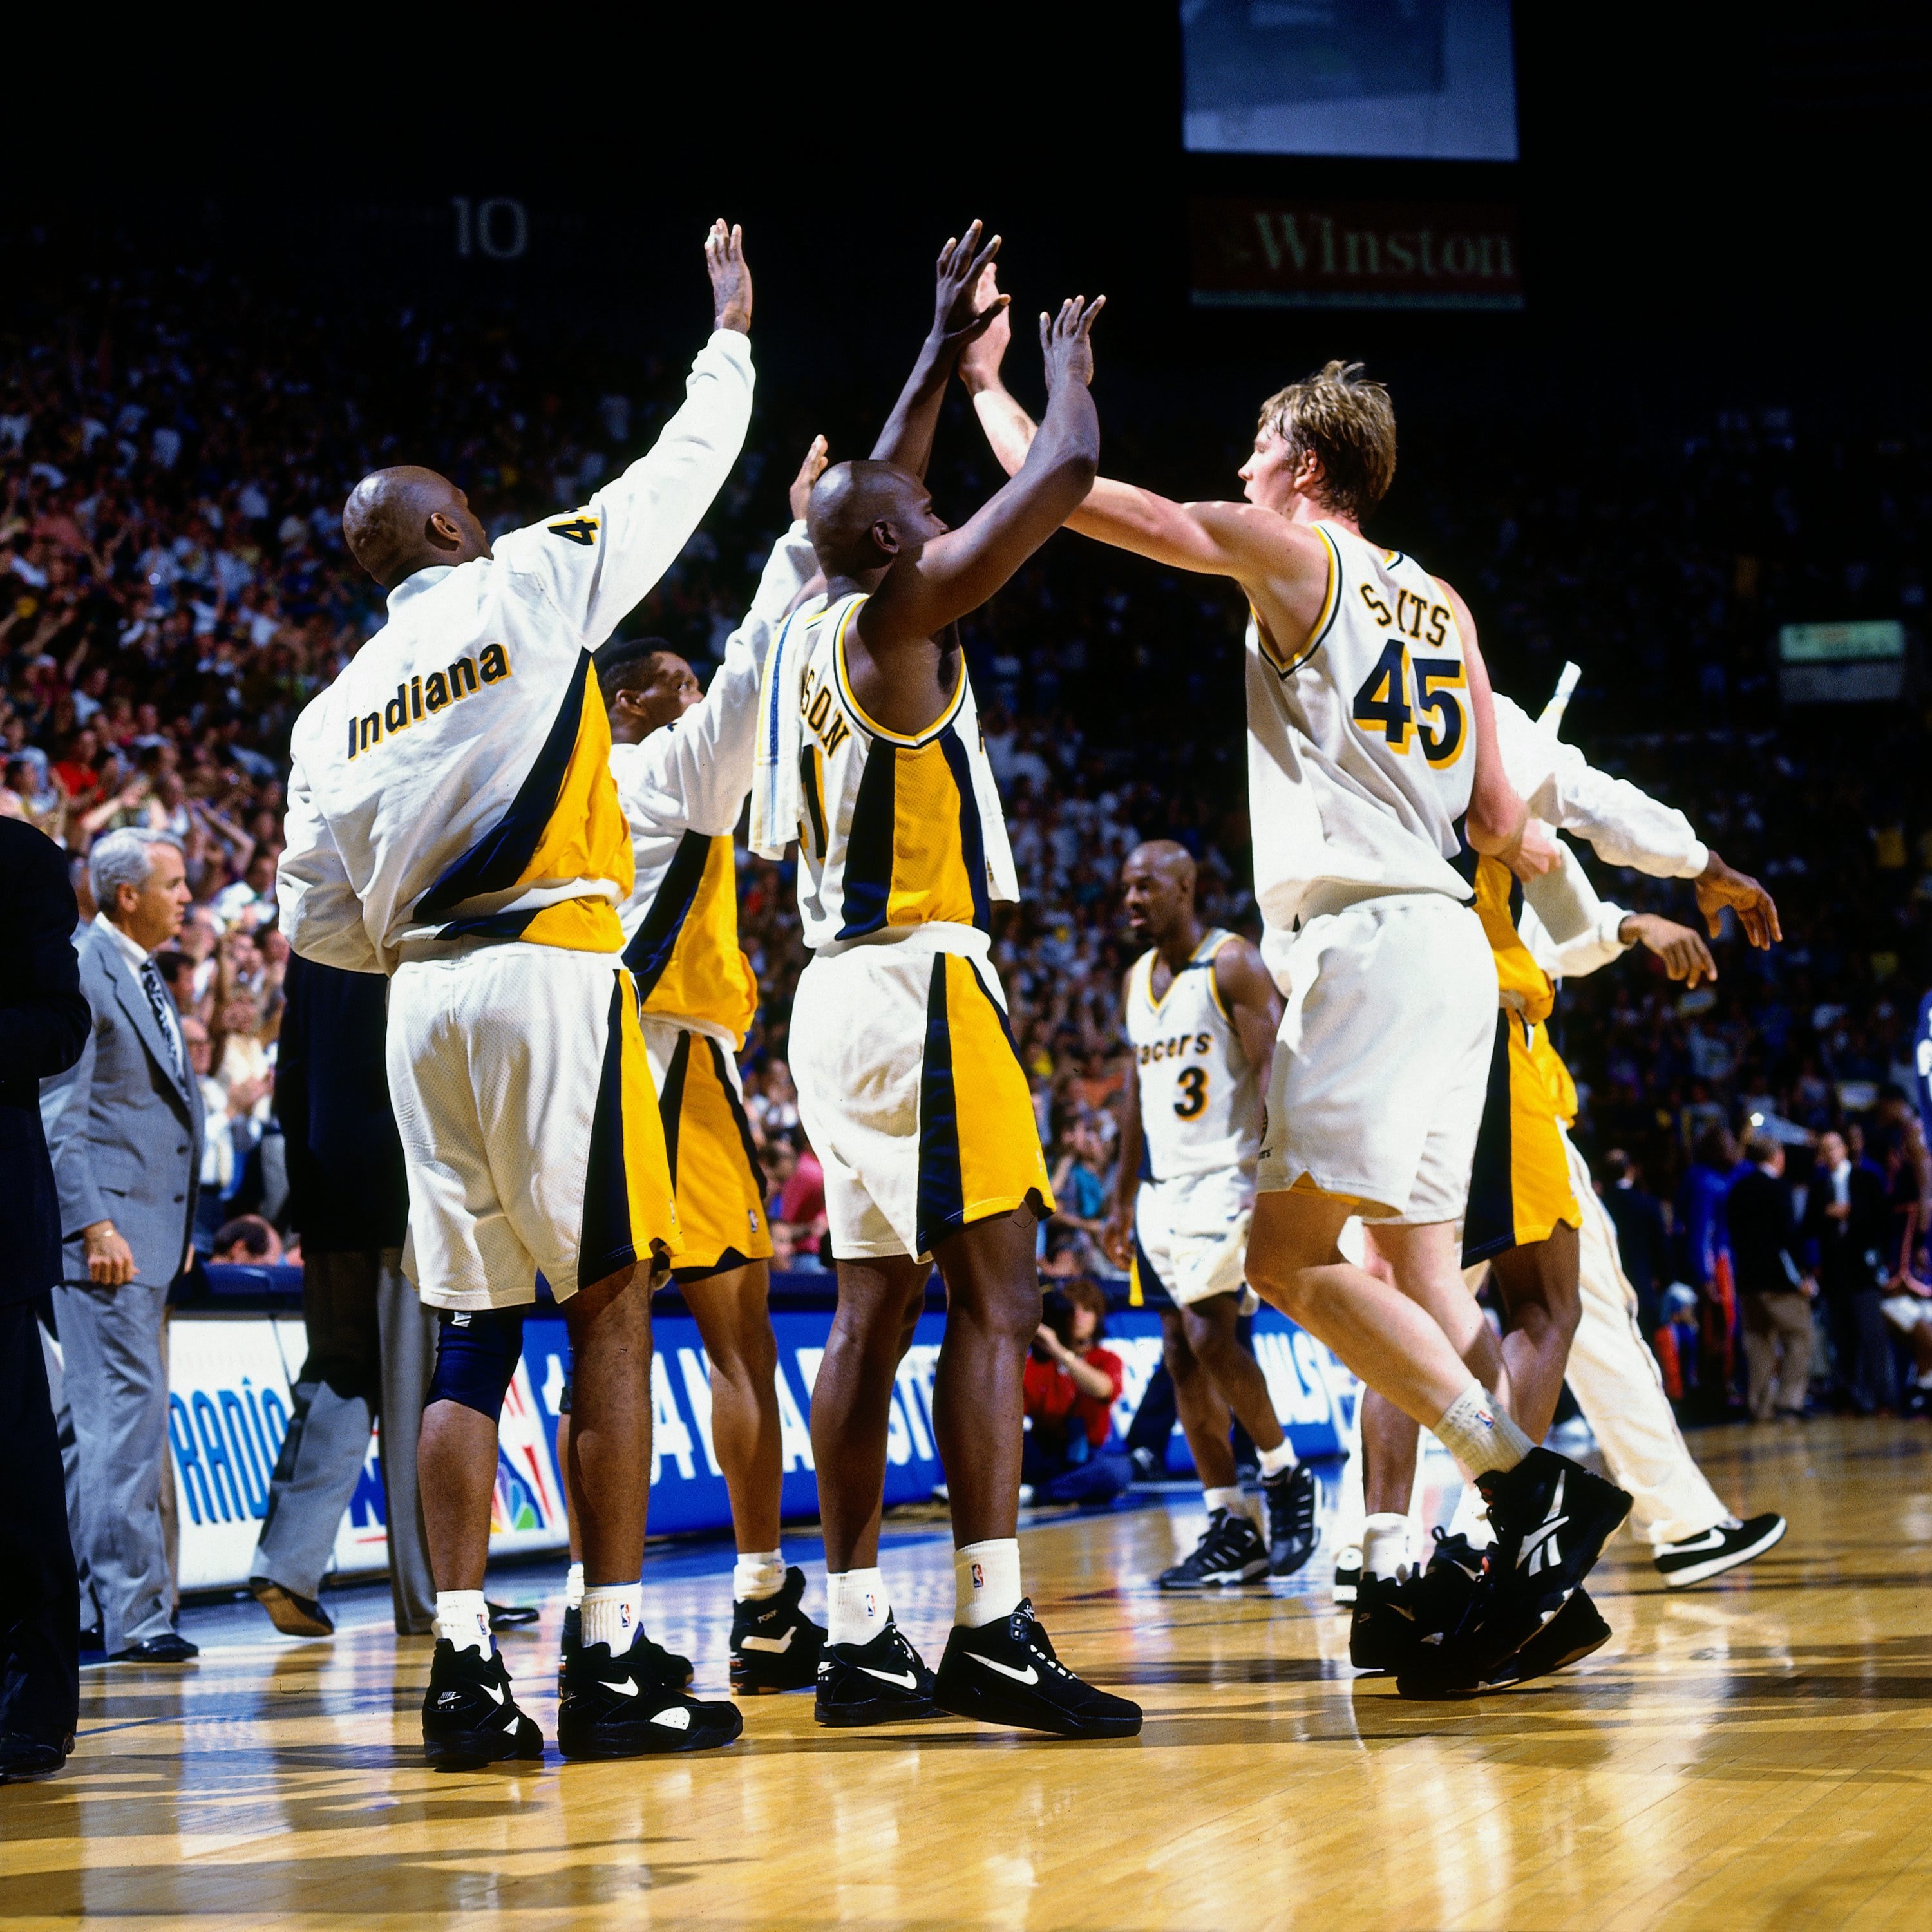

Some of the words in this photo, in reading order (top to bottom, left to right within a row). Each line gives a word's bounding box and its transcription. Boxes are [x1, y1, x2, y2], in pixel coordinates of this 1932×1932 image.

[451, 195, 531, 260] 10
[1251, 210, 1517, 277] Winston
[547, 507, 600, 545] 4
[348, 643, 511, 761] Indiana
[800, 668, 852, 759] SON
[1353, 639, 1468, 770] 45
[1135, 1032, 1213, 1065] acers
[1173, 1066, 1210, 1122] 3
